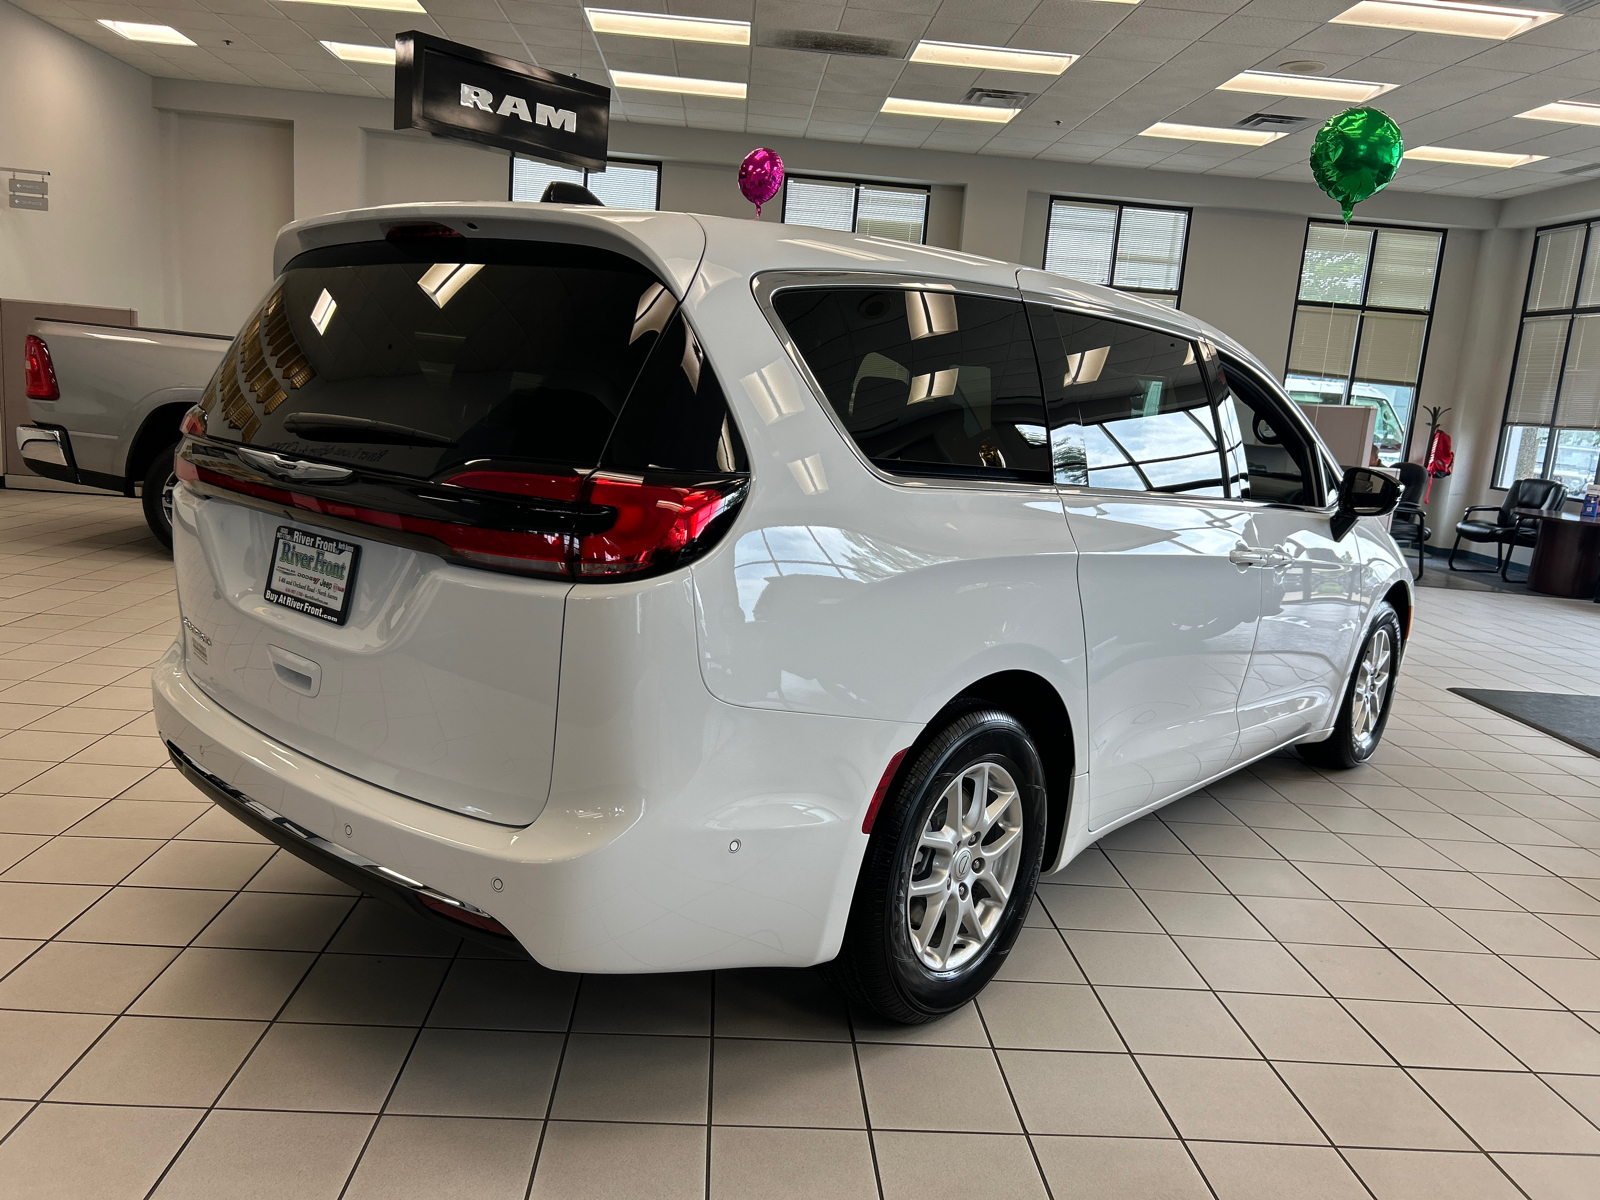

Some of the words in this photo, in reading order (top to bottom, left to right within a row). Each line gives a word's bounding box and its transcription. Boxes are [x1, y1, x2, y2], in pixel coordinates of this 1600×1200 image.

[460, 83, 577, 133] RAM
[293, 530, 315, 547] River
[315, 536, 337, 553] Front
[279, 541, 315, 570] River
[312, 549, 346, 580] Front
[320, 578, 333, 590] Jeep
[265, 589, 279, 603] Buy
[278, 594, 286, 605] At
[286, 596, 304, 611] River
[303, 602, 338, 623] Front.com
